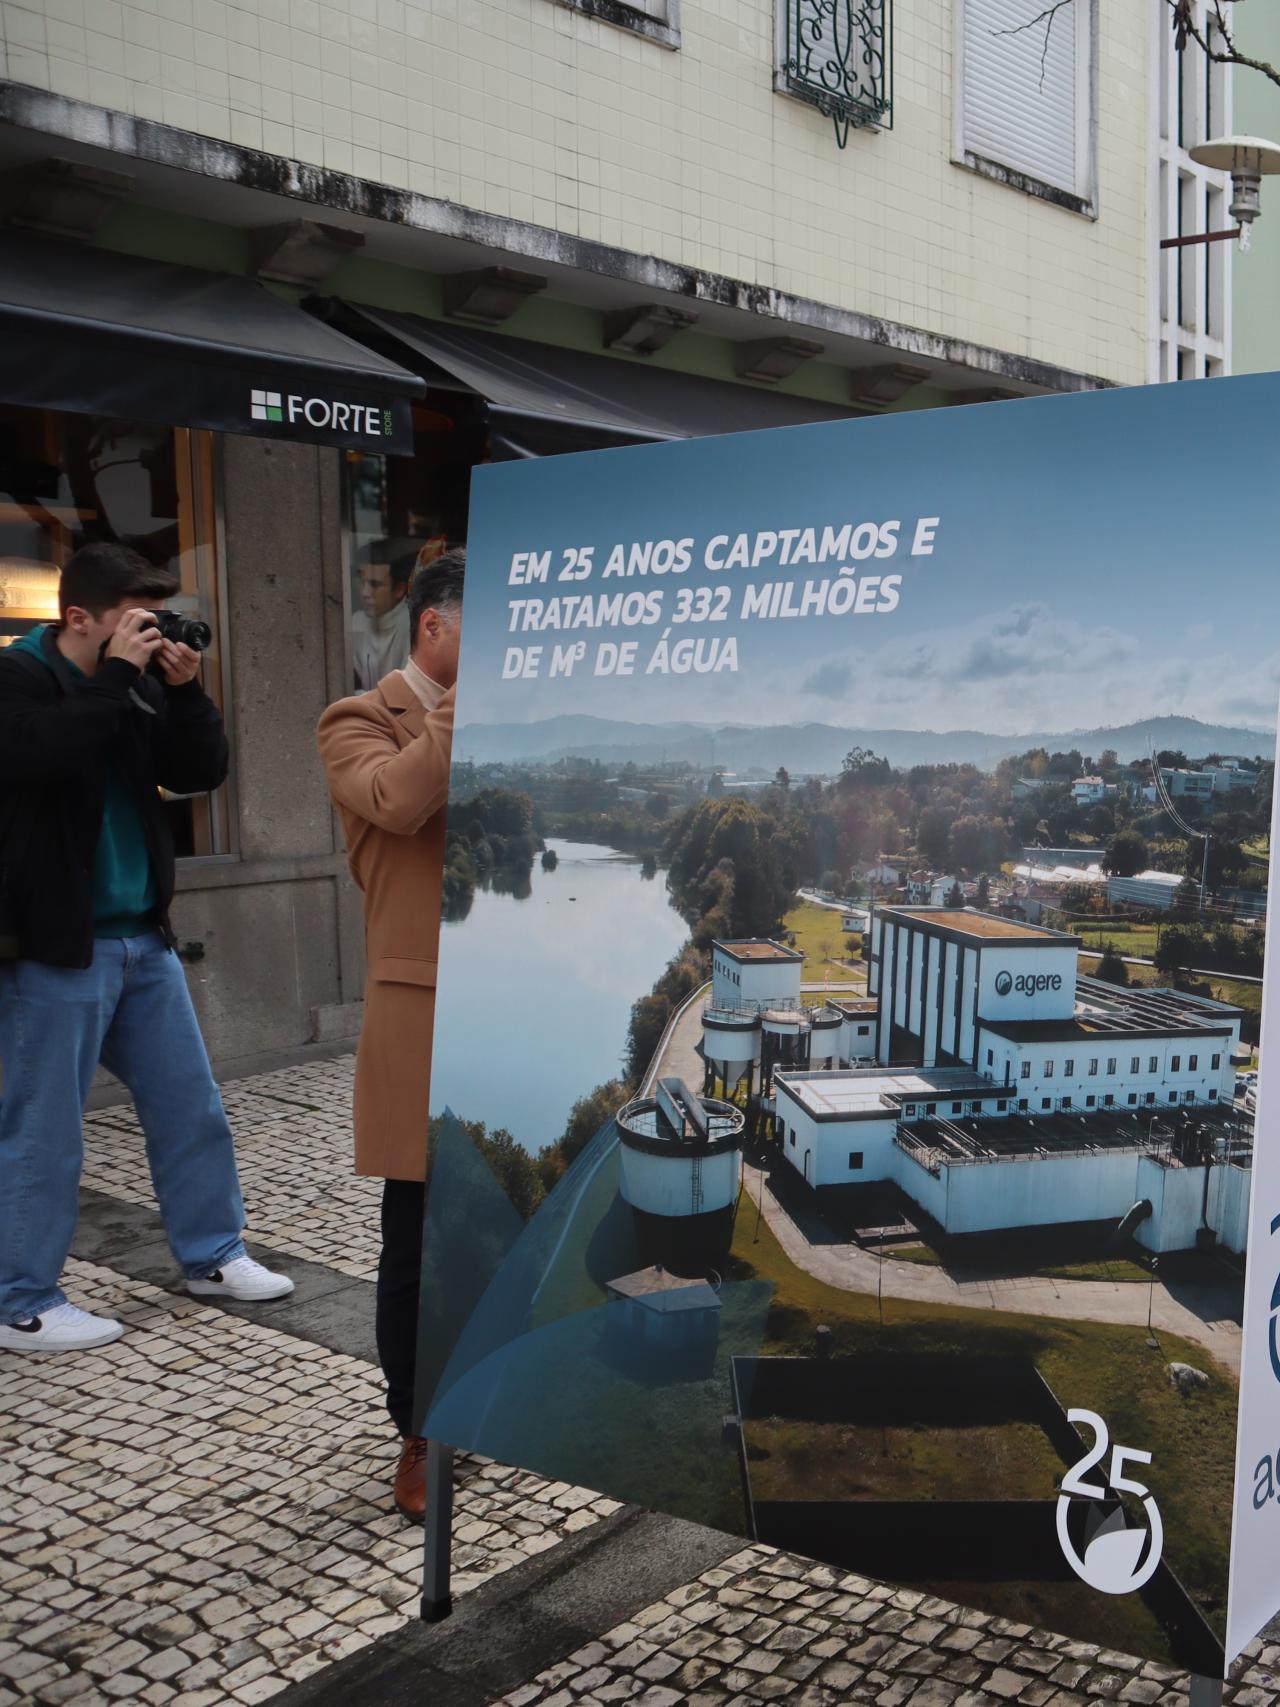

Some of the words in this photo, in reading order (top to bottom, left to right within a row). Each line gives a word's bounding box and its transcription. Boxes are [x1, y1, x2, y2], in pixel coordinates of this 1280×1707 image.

[287, 394, 381, 436] FORTE
[383, 409, 393, 436] STORE
[508, 550, 552, 585] EM
[557, 546, 595, 582] 25
[602, 537, 695, 578] ANOS
[704, 520, 901, 571] CAPTAMOS
[910, 517, 940, 556] E
[508, 590, 664, 632] TRATAMOS
[671, 585, 732, 623] 332
[740, 567, 903, 619] MILHÕES
[501, 646, 543, 679] DE
[594, 641, 639, 676] DE
[645, 627, 739, 674] ÁGUA
[1014, 974, 1062, 997] agere
[1061, 1408, 1152, 1500] 25
